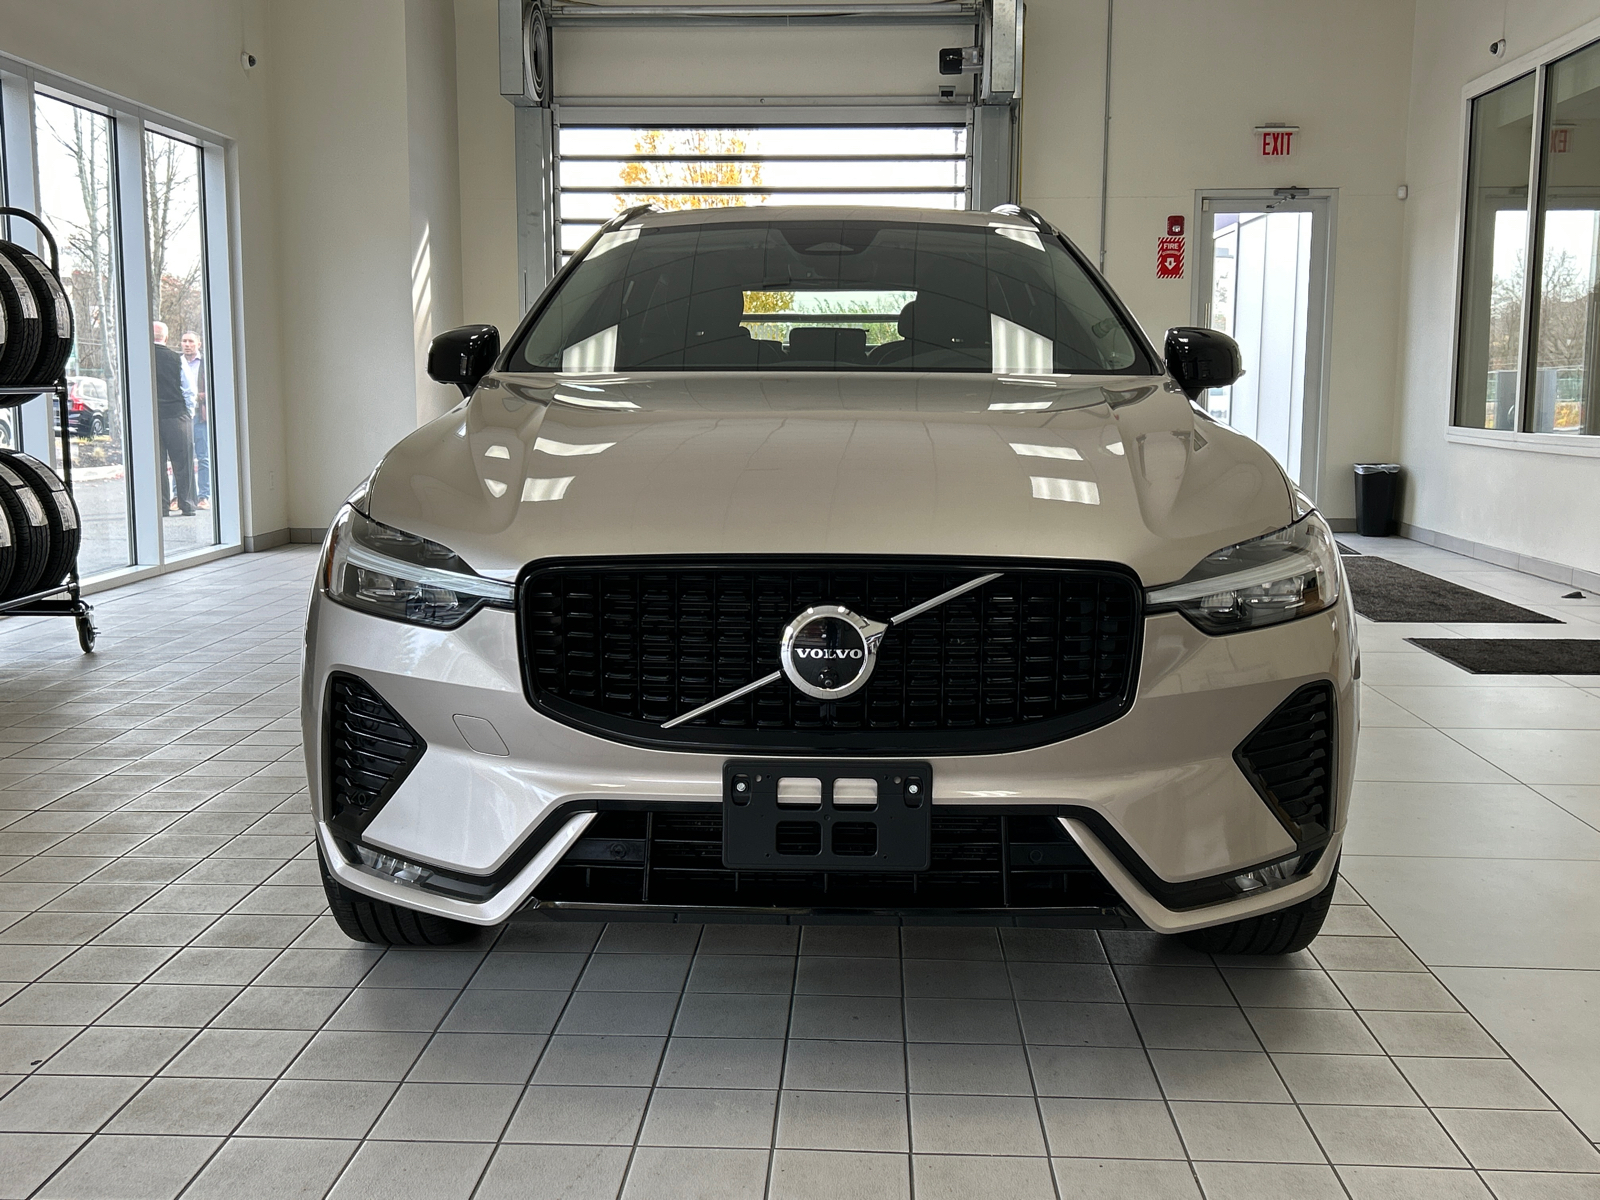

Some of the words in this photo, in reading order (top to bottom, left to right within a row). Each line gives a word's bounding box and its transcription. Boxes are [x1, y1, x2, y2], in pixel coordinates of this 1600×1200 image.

[1262, 132, 1293, 156] EXIT
[1163, 242, 1179, 250] FIRE
[794, 648, 863, 659] VOLVO
